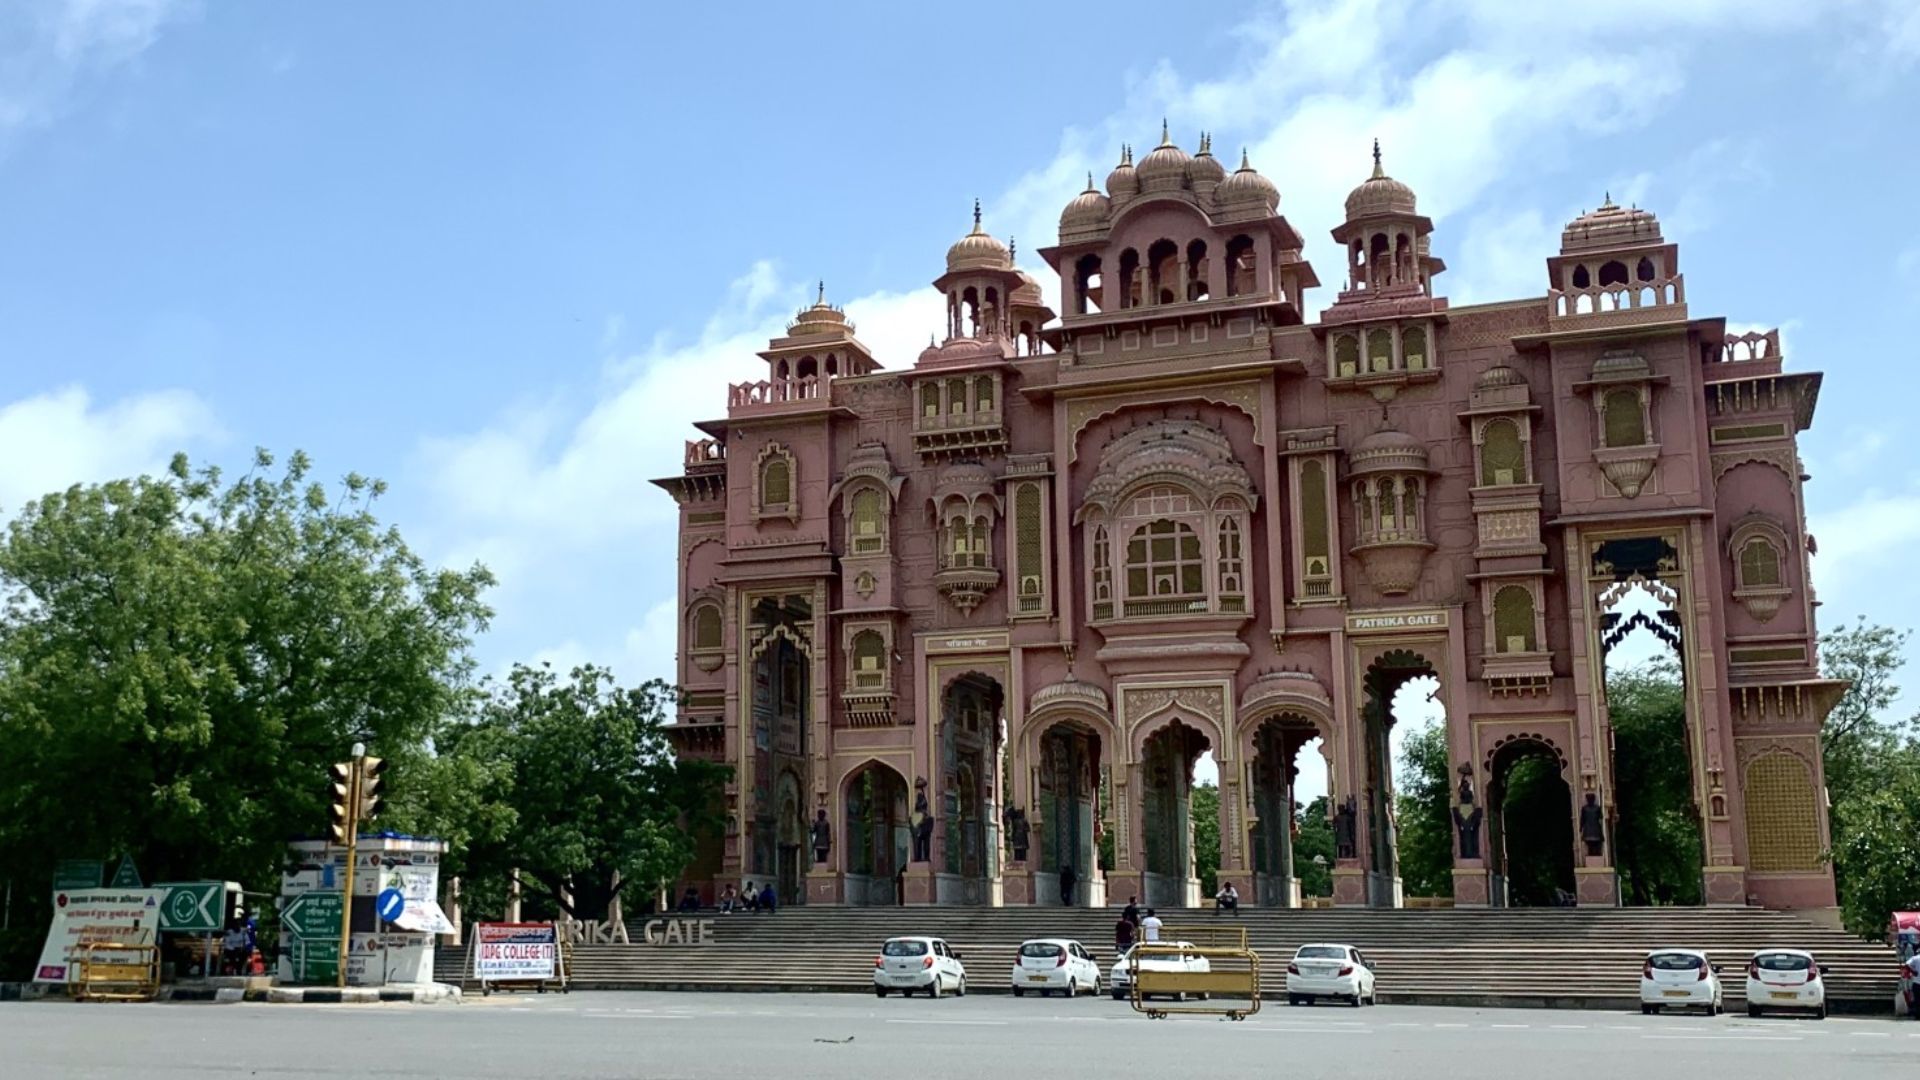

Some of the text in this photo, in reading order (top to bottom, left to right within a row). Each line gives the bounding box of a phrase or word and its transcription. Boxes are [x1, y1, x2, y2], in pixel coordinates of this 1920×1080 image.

[1355, 614, 1439, 628] PATRIKA GATE
[305, 918, 326, 926] Airport
[644, 919, 715, 944] GATE
[503, 944, 541, 959] COLLEGE
